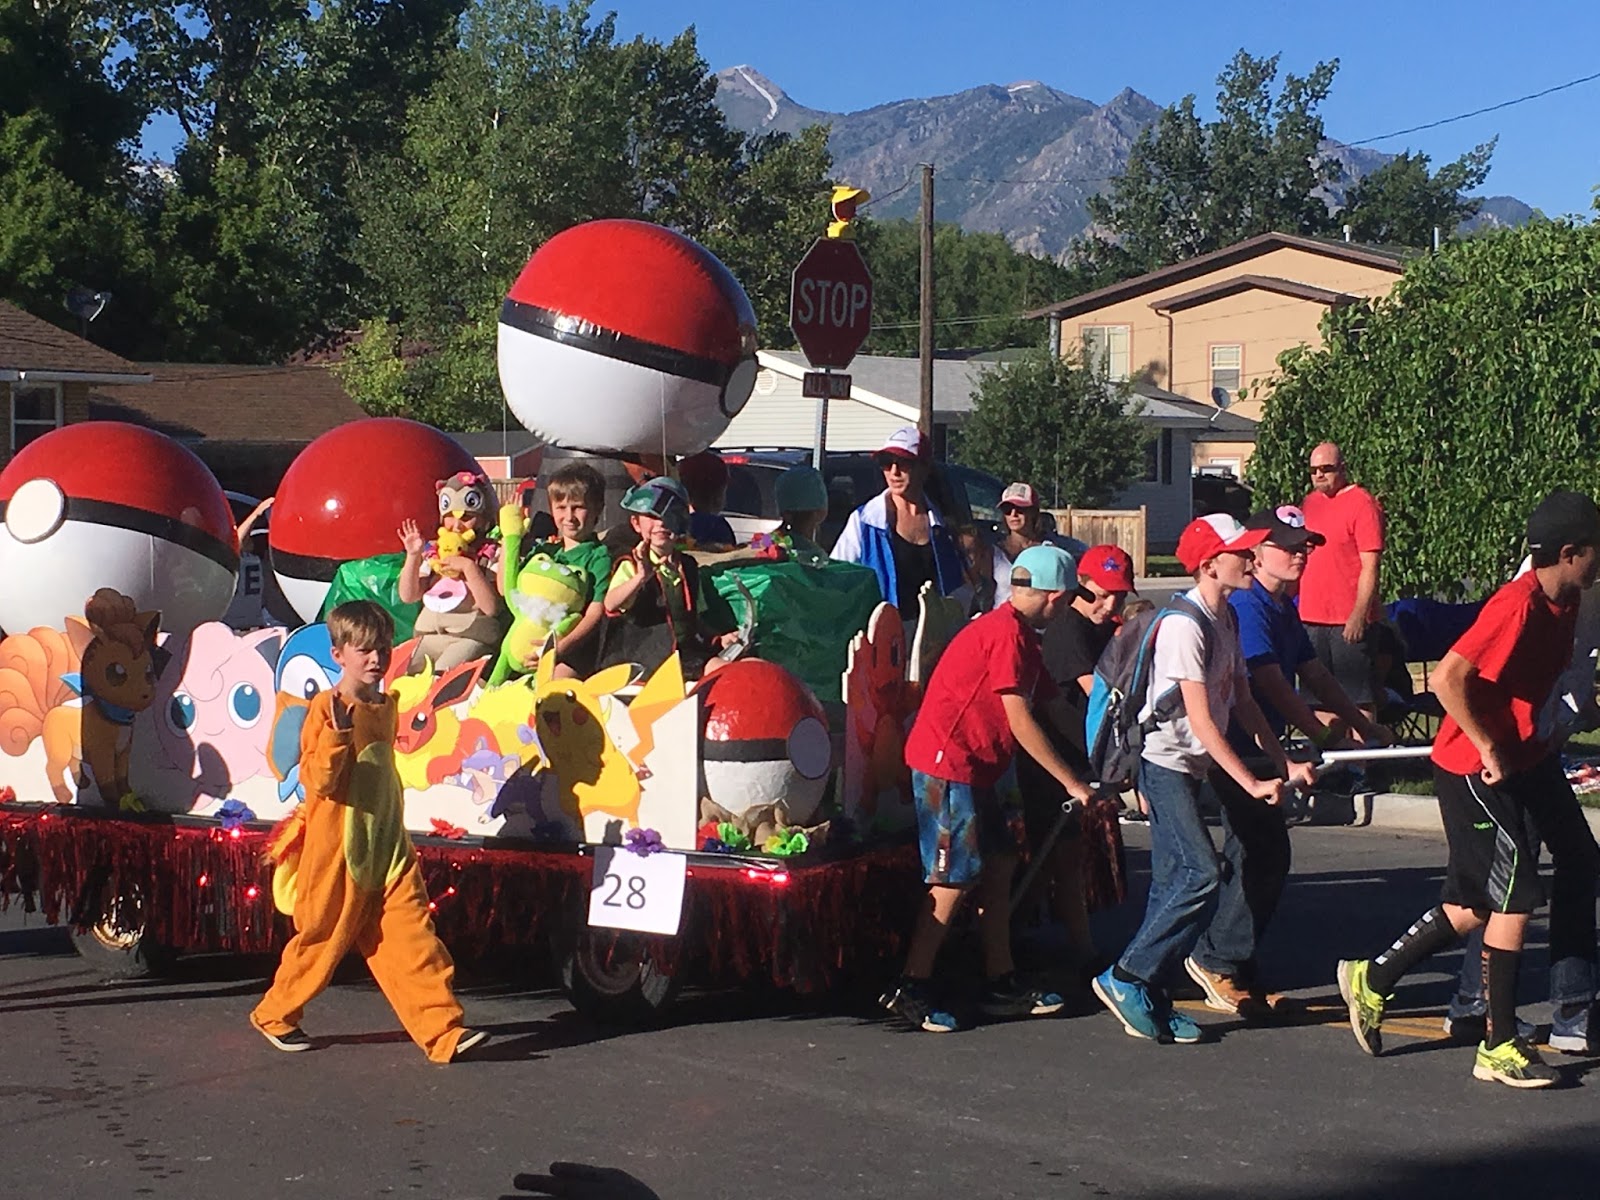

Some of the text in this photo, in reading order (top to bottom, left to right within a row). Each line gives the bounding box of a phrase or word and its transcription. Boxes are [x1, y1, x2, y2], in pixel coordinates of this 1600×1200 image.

[798, 277, 867, 327] STOP
[804, 375, 851, 397] ALL WAY
[602, 873, 646, 909] 28
